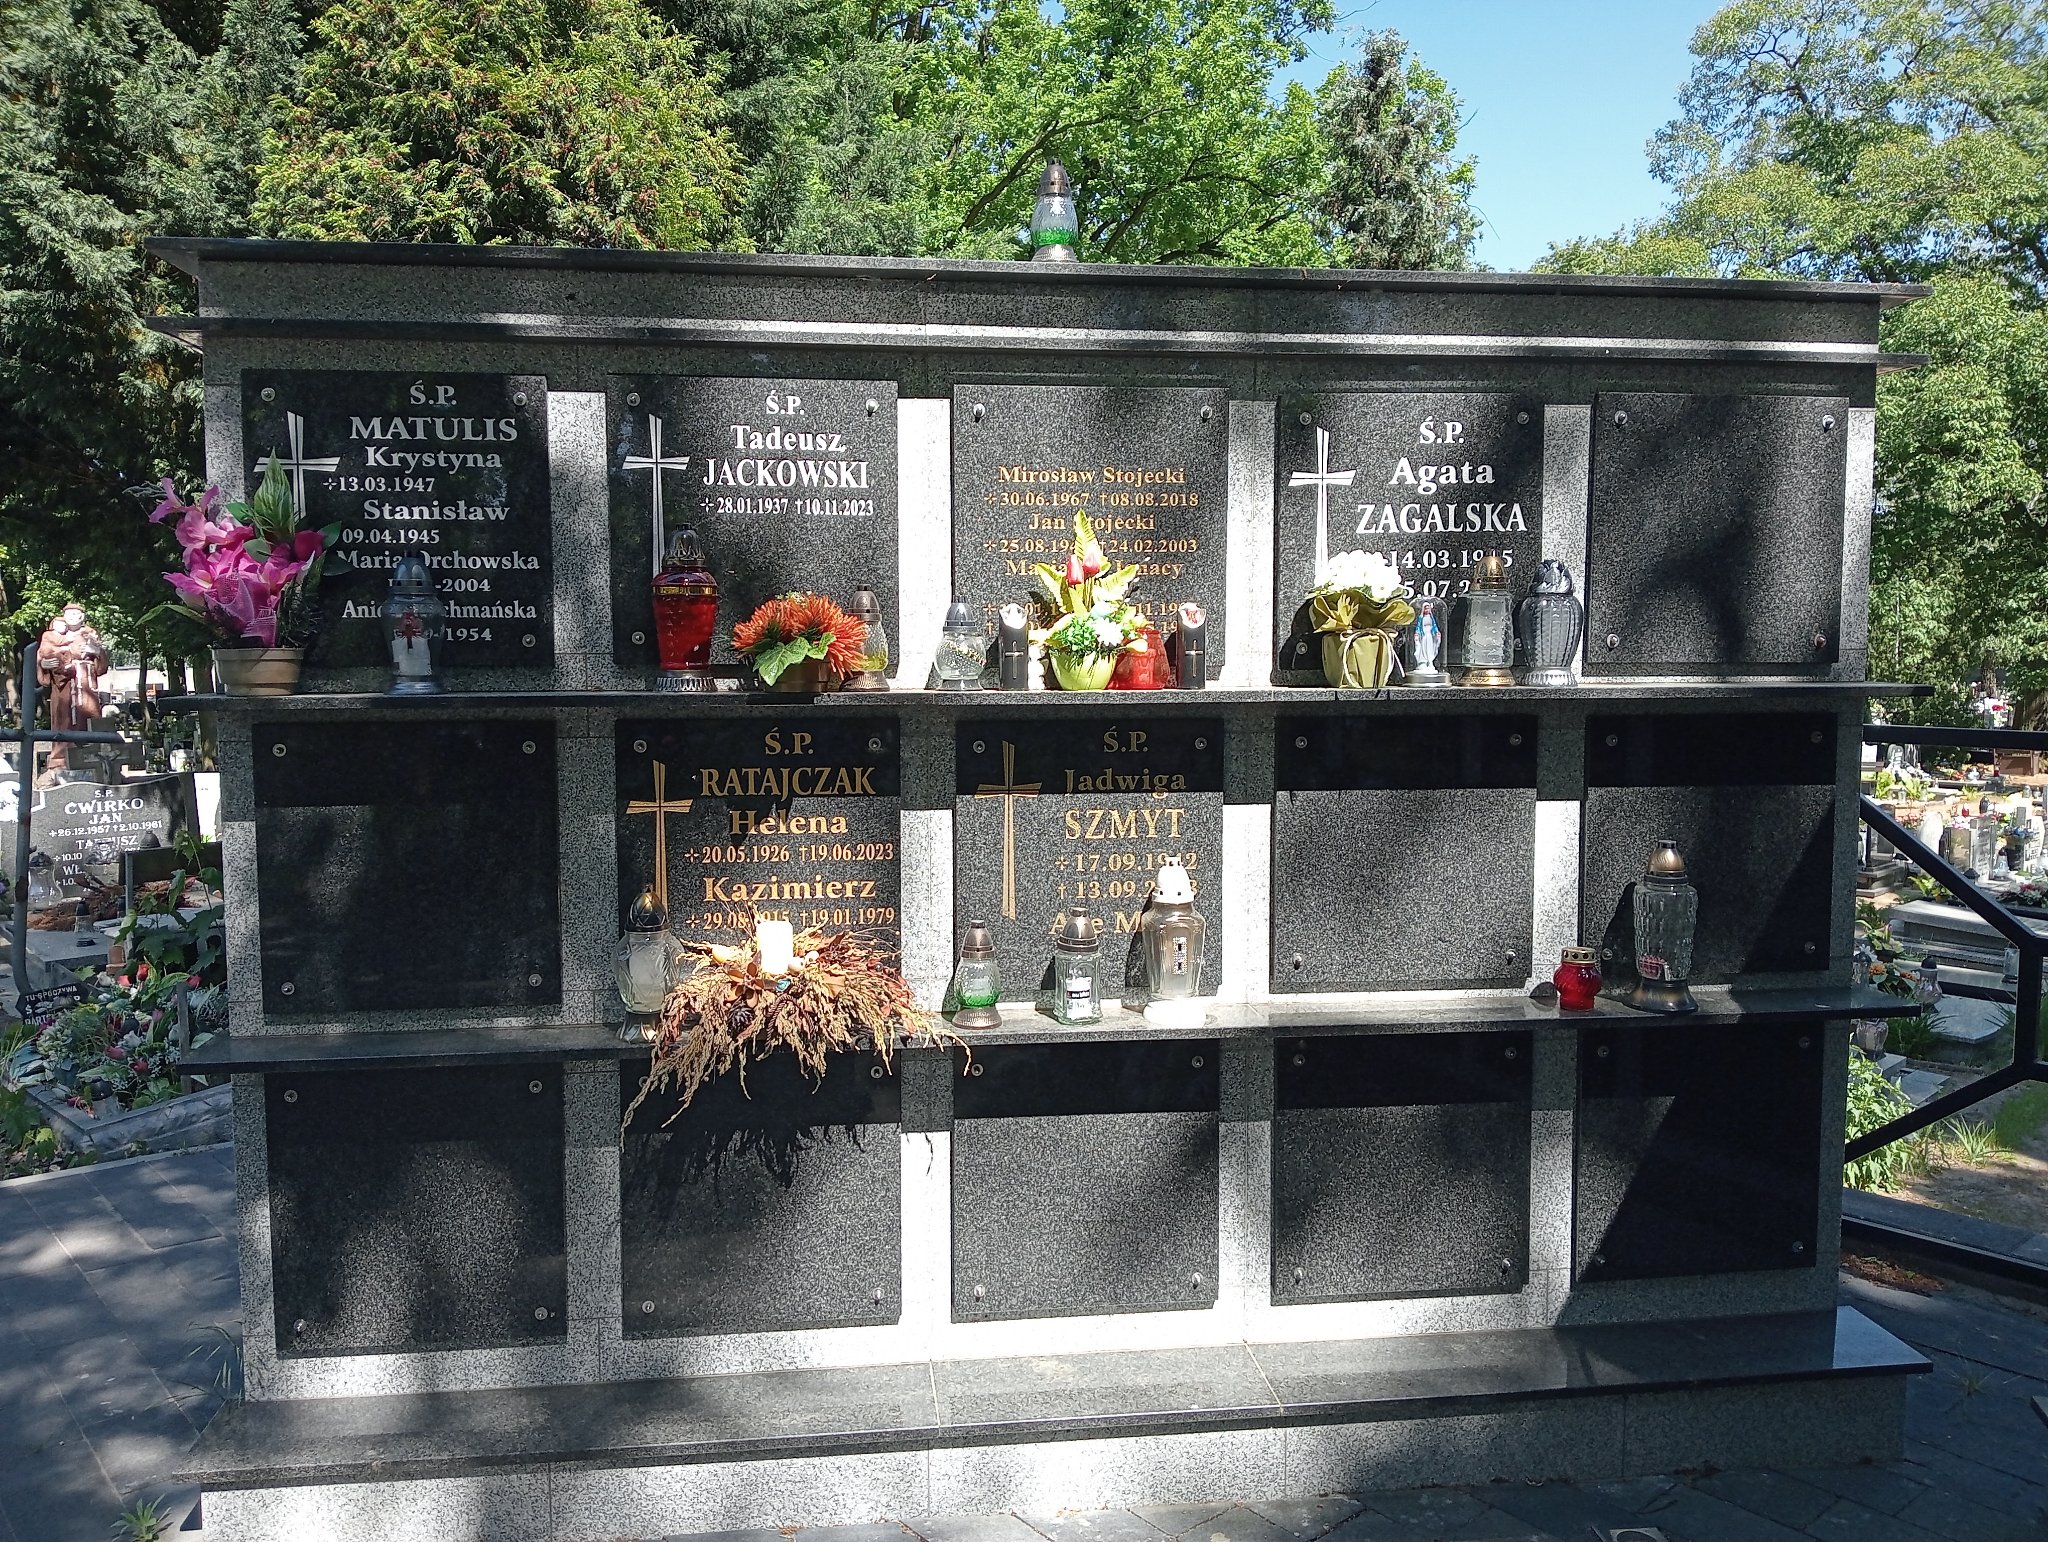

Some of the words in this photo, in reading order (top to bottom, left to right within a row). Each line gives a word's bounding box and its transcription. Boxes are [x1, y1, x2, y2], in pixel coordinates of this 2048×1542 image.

[409, 380, 457, 406] Ś.P.
[765, 389, 806, 416] Ś.P.
[350, 415, 519, 442] MATULIS
[730, 424, 847, 452] Tadeusz
[1419, 415, 1466, 445] Ś.P.
[365, 446, 503, 474] Krystyna
[338, 476, 436, 493] 13.03.1947
[702, 458, 870, 489] JACKOWSKI
[998, 466, 1096, 484] Mirosław
[1103, 466, 1186, 488] Stojecki
[1388, 455, 1496, 496] Agata
[363, 499, 511, 521] Stanisław
[716, 497, 789, 515] 28.01.1937
[804, 498, 874, 517] 10.11.2023
[1000, 491, 1090, 507] 30.06.1967
[1110, 491, 1200, 507] 08.08.2018
[1028, 512, 1066, 531] Jan
[1074, 513, 1156, 534] tojecki
[1355, 502, 1529, 534] ZAGALSKA
[341, 528, 441, 545] 09.04.1945
[999, 538, 1076, 554] 25.08.194
[1109, 538, 1199, 554] 24.02.2003
[1005, 558, 1069, 576] Maia
[1390, 548, 1514, 569] 14.03.195
[764, 727, 815, 756] Ś.P.
[1102, 726, 1150, 754] Ś.P.
[699, 766, 877, 802] RATAJCZAK
[1063, 768, 1187, 799] Jadwiga
[88, 812, 123, 825] JAN
[728, 808, 849, 836] Helena
[1064, 807, 1187, 841] SZMYT
[702, 844, 791, 864] 20.05.1926
[810, 842, 895, 862] 19.06.2023
[1075, 852, 1199, 872] 17.09.192
[702, 874, 877, 902] Kazimierz
[1075, 879, 1199, 899] 13.09.23
[811, 906, 896, 926] 19.01.1979
[1048, 911, 1105, 935] Ae
